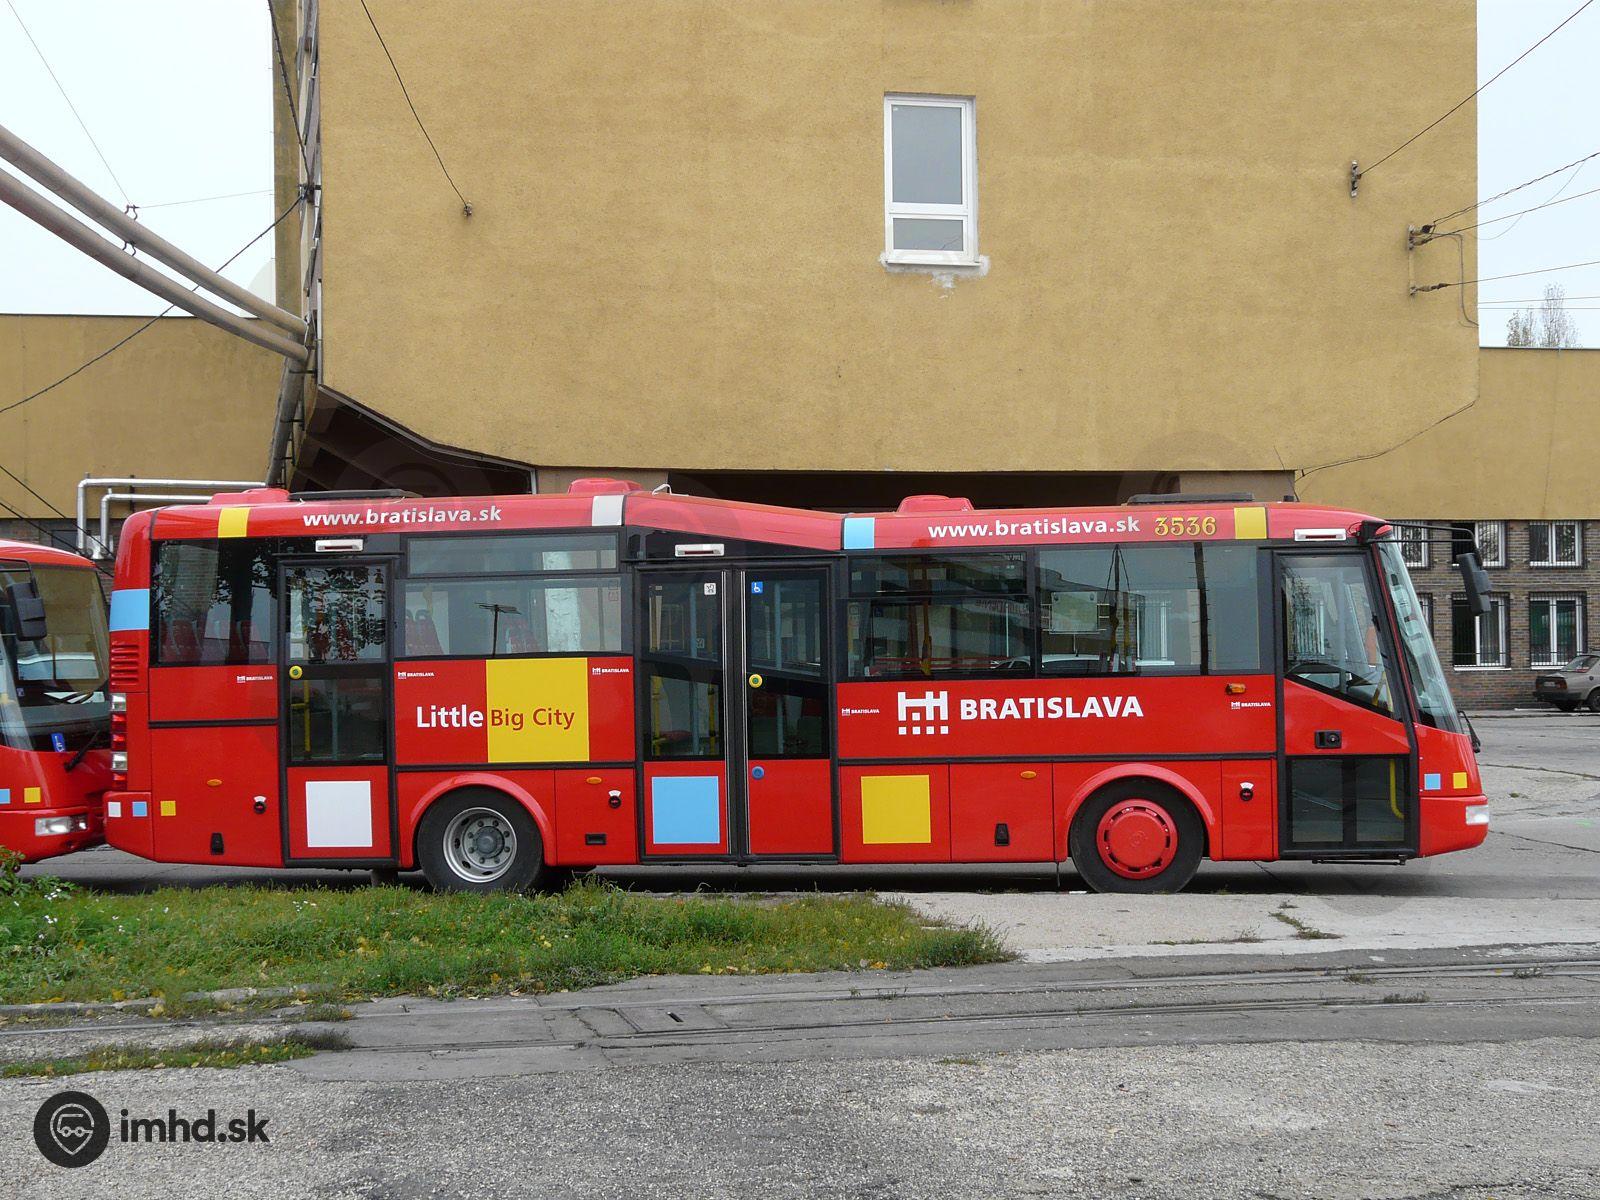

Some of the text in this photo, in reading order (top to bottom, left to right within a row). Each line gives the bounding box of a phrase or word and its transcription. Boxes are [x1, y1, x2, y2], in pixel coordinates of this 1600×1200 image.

[303, 505, 502, 527] www.bratislava.sk
[927, 515, 1141, 538] www.bratislava.sk
[1154, 516, 1217, 536] 3536
[416, 704, 575, 731] Little Big City
[960, 696, 1145, 721] BRATISLAVA
